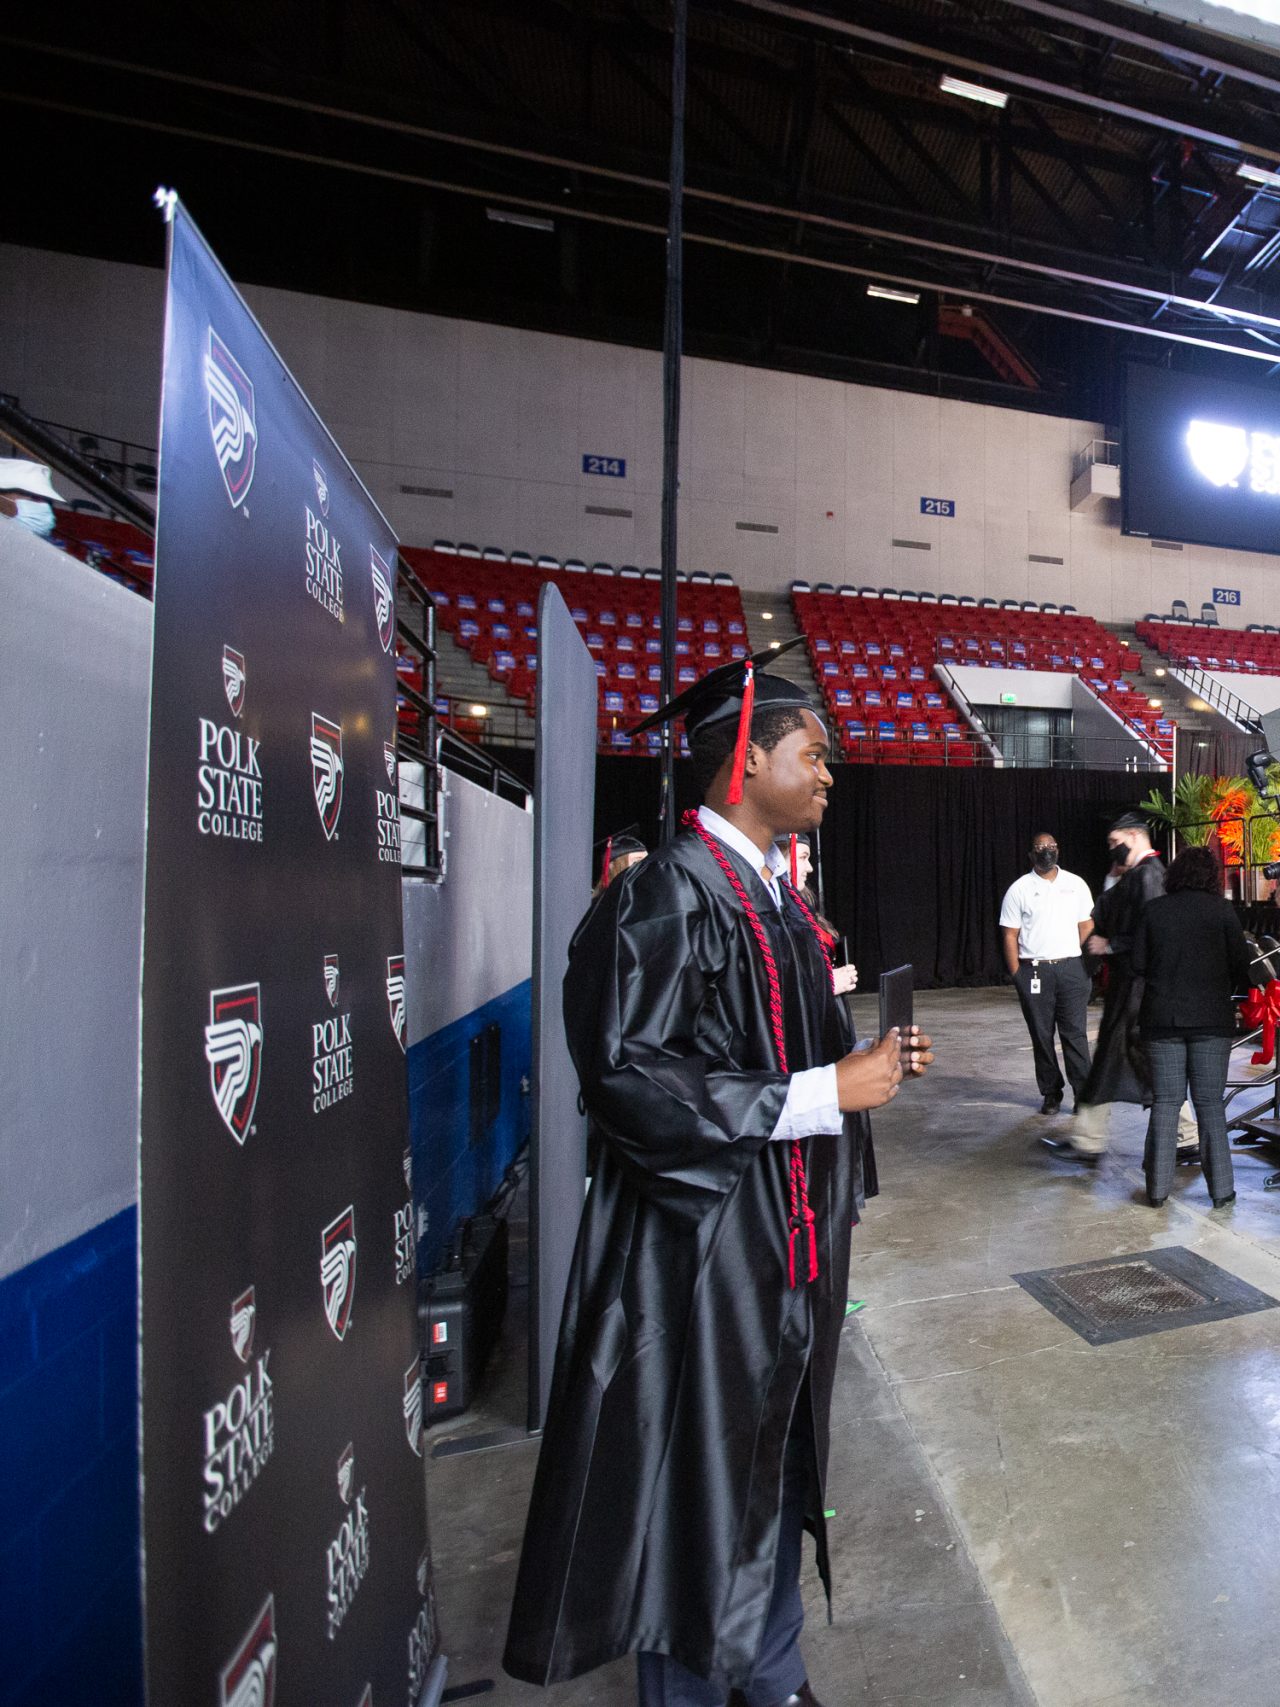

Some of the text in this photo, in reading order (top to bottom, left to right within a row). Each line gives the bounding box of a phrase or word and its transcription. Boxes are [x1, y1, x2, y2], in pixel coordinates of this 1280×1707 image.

[589, 457, 619, 475] 214
[925, 499, 951, 515] 215
[305, 505, 342, 575] POLK
[306, 541, 343, 606] STATE
[1216, 590, 1238, 604] 216
[306, 576, 345, 624] COLLEGE
[198, 717, 262, 779] POLK
[198, 765, 263, 820] STATE
[375, 789, 401, 822] POL
[198, 811, 264, 843] COLLEGE
[312, 1013, 353, 1058] POLK
[313, 1045, 353, 1095] STATE
[313, 1078, 353, 1114] COLLEGE
[204, 1347, 273, 1460] POLK
[203, 1391, 274, 1510] STATE
[204, 1431, 275, 1534] COLLEGE
[326, 1485, 369, 1585] POLK
